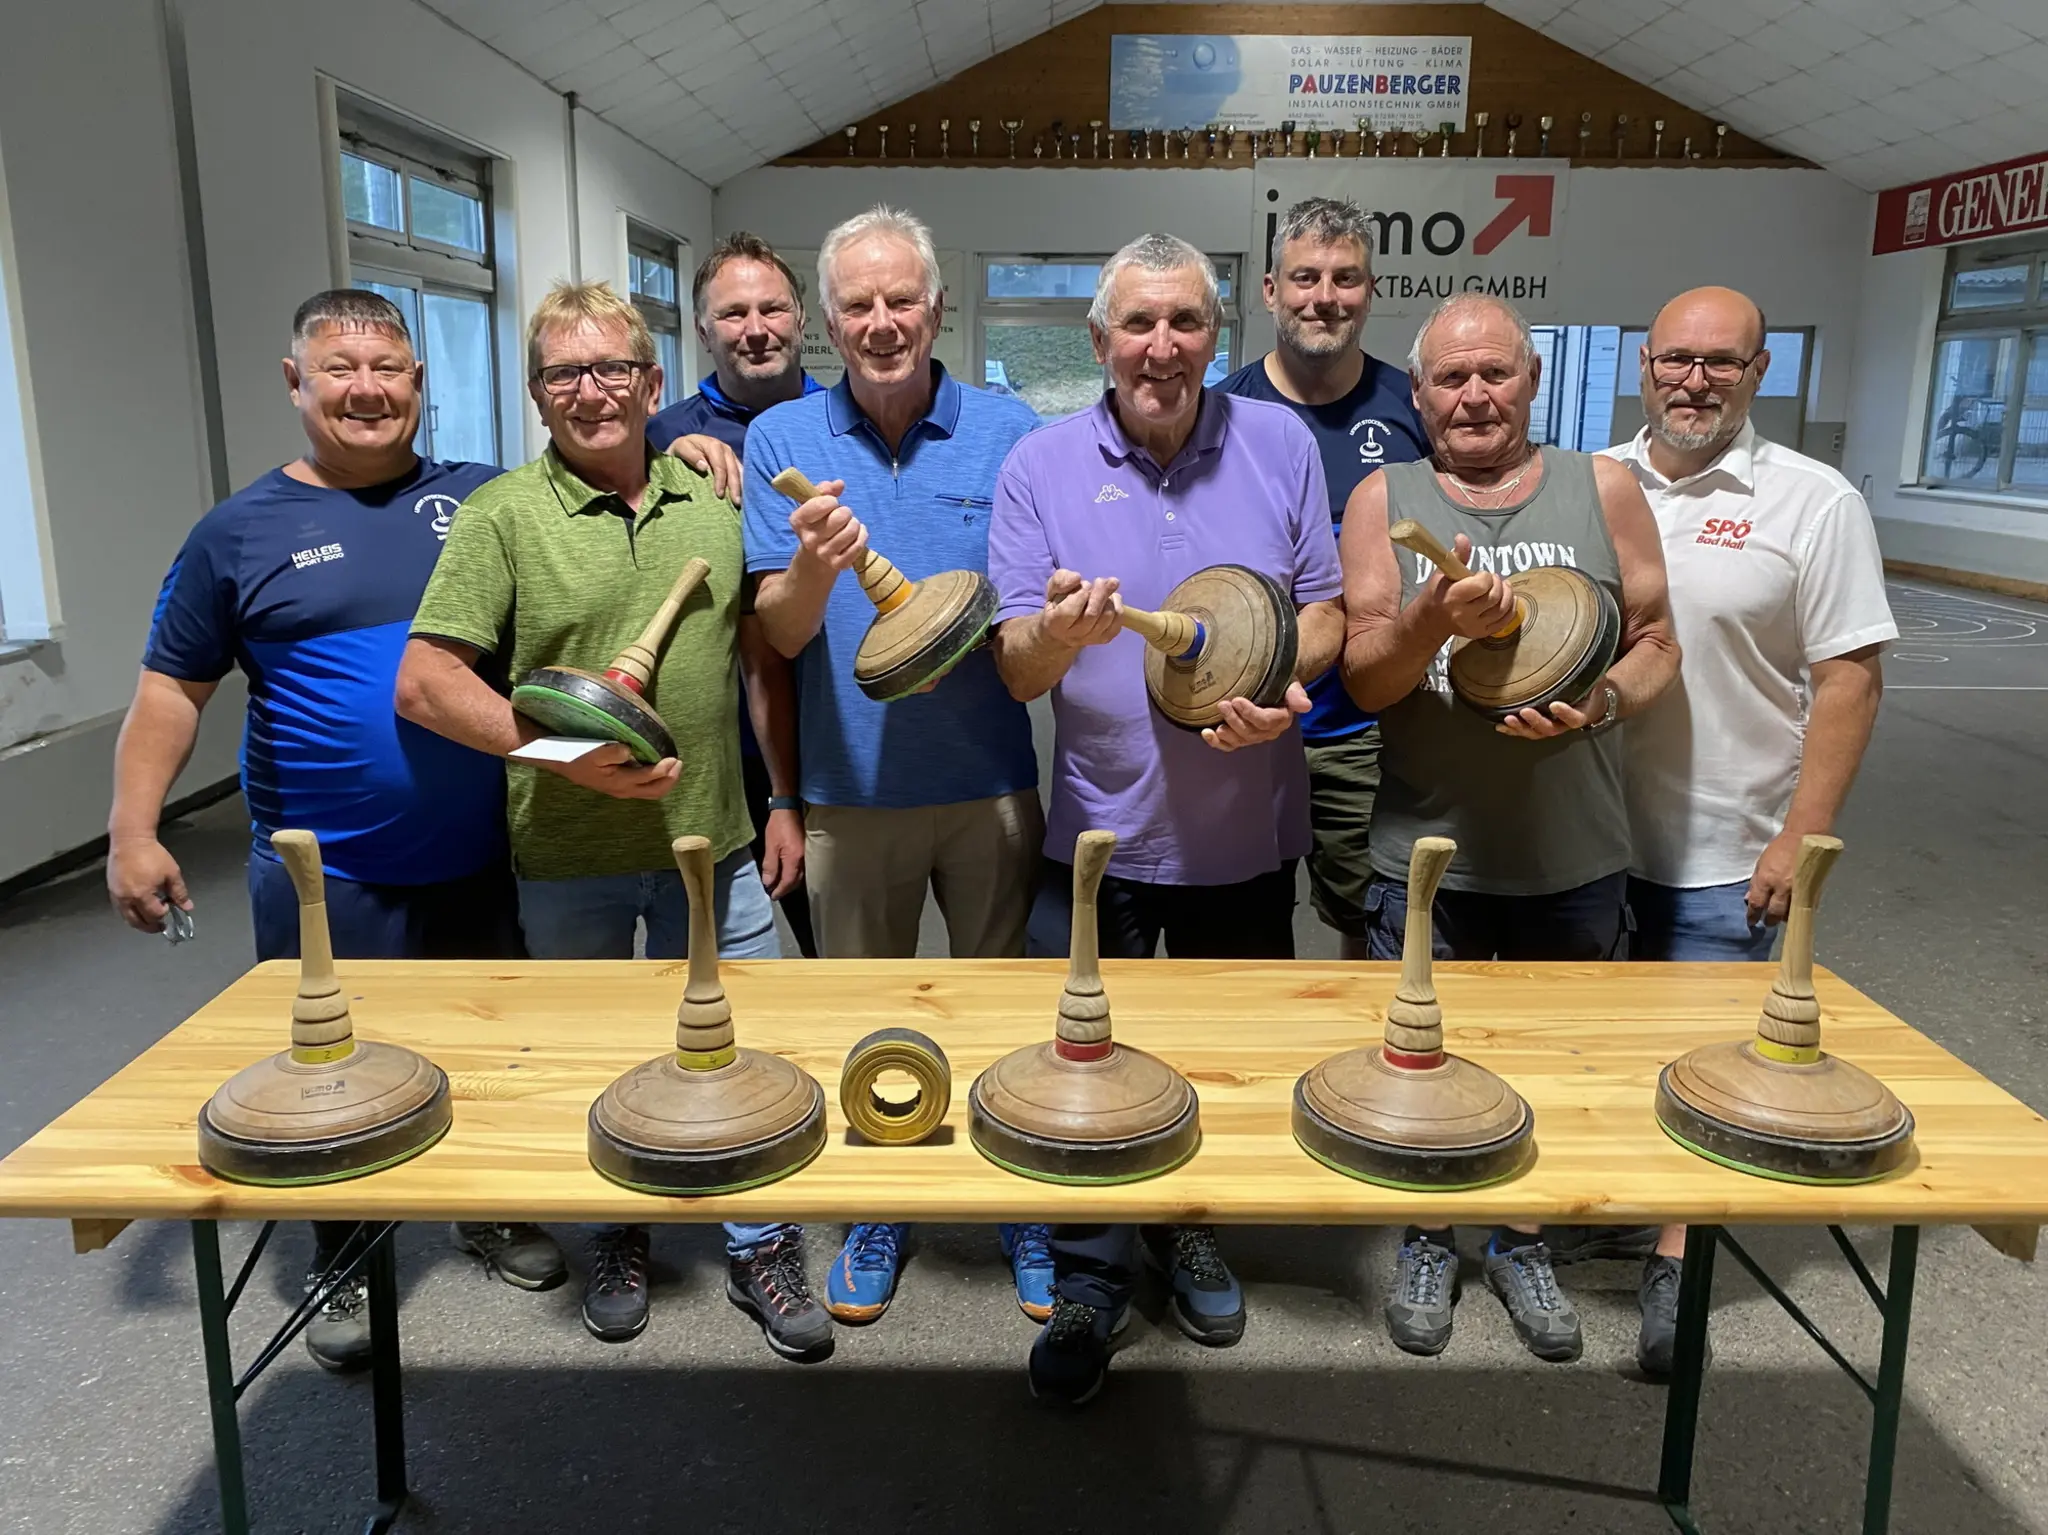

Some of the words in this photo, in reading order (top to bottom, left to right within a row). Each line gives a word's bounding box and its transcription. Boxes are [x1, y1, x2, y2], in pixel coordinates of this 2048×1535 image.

[1291, 47, 1312, 56] GAS
[1324, 46, 1362, 55] WASSER
[1375, 46, 1418, 56] HEIZUNG
[1290, 58, 1330, 68] SOLAR
[1350, 58, 1405, 68] LÜFTUNG
[1425, 58, 1463, 68] KLIMA
[1289, 74, 1462, 95] PAUZENBERGER
[1288, 100, 1422, 109] INSTALLATIONSTECHNIK
[1426, 100, 1461, 109] GMBH
[1372, 274, 1454, 298] KTBAU
[1463, 274, 1547, 298] GMBH
[800, 343, 834, 355] ÜBERL
[1701, 518, 1753, 539] SPÖ
[1696, 535, 1721, 546] Bad
[1720, 538, 1746, 551] Hall
[291, 543, 343, 564] HELLEIS
[295, 557, 321, 570] SPORT
[322, 552, 345, 562] 2000
[1415, 541, 1577, 585] DNTOWN
